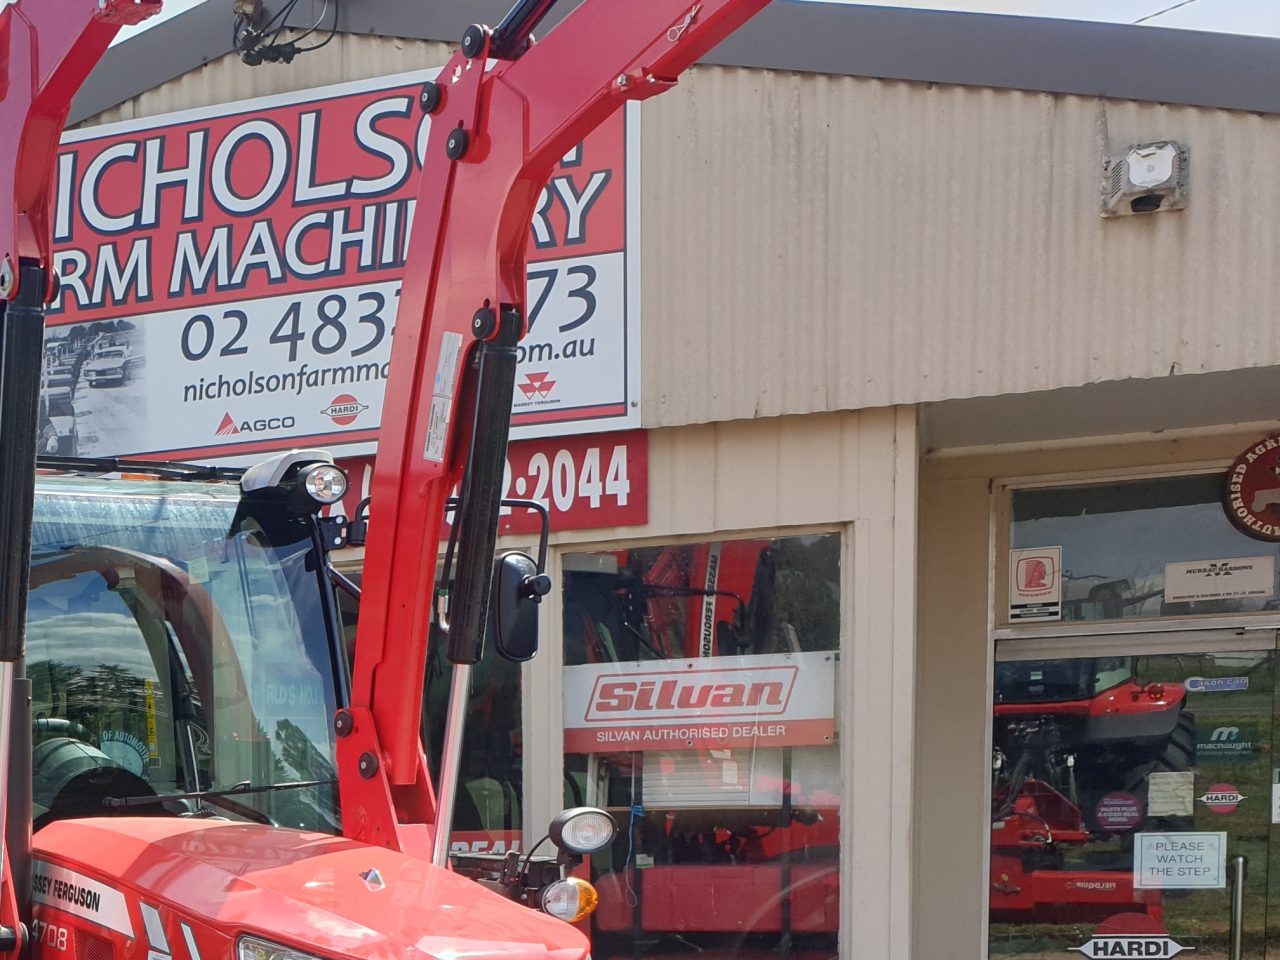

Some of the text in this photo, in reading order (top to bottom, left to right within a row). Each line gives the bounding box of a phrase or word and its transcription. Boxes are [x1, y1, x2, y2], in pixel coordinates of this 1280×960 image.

[53, 95, 583, 243] ICHOLS
[47, 168, 613, 314] RM MACHIRY
[181, 263, 597, 363] 02 483 73
[330, 404, 359, 415] HARDI
[239, 416, 295, 432] AGCO
[595, 680, 783, 712] Silvan
[103, 730, 113, 740] OF
[597, 725, 786, 742] SILVAN AUTHORISED DEALER
[1197, 741, 1251, 750] macnaught
[1155, 842, 1205, 851] PLEASE
[1156, 855, 1203, 864] WATCH
[1149, 867, 1211, 876] THE STEP
[32, 873, 100, 912] SSEY FERGUSON
[32, 918, 67, 951] 4708
[1093, 941, 1169, 956] HARDI
